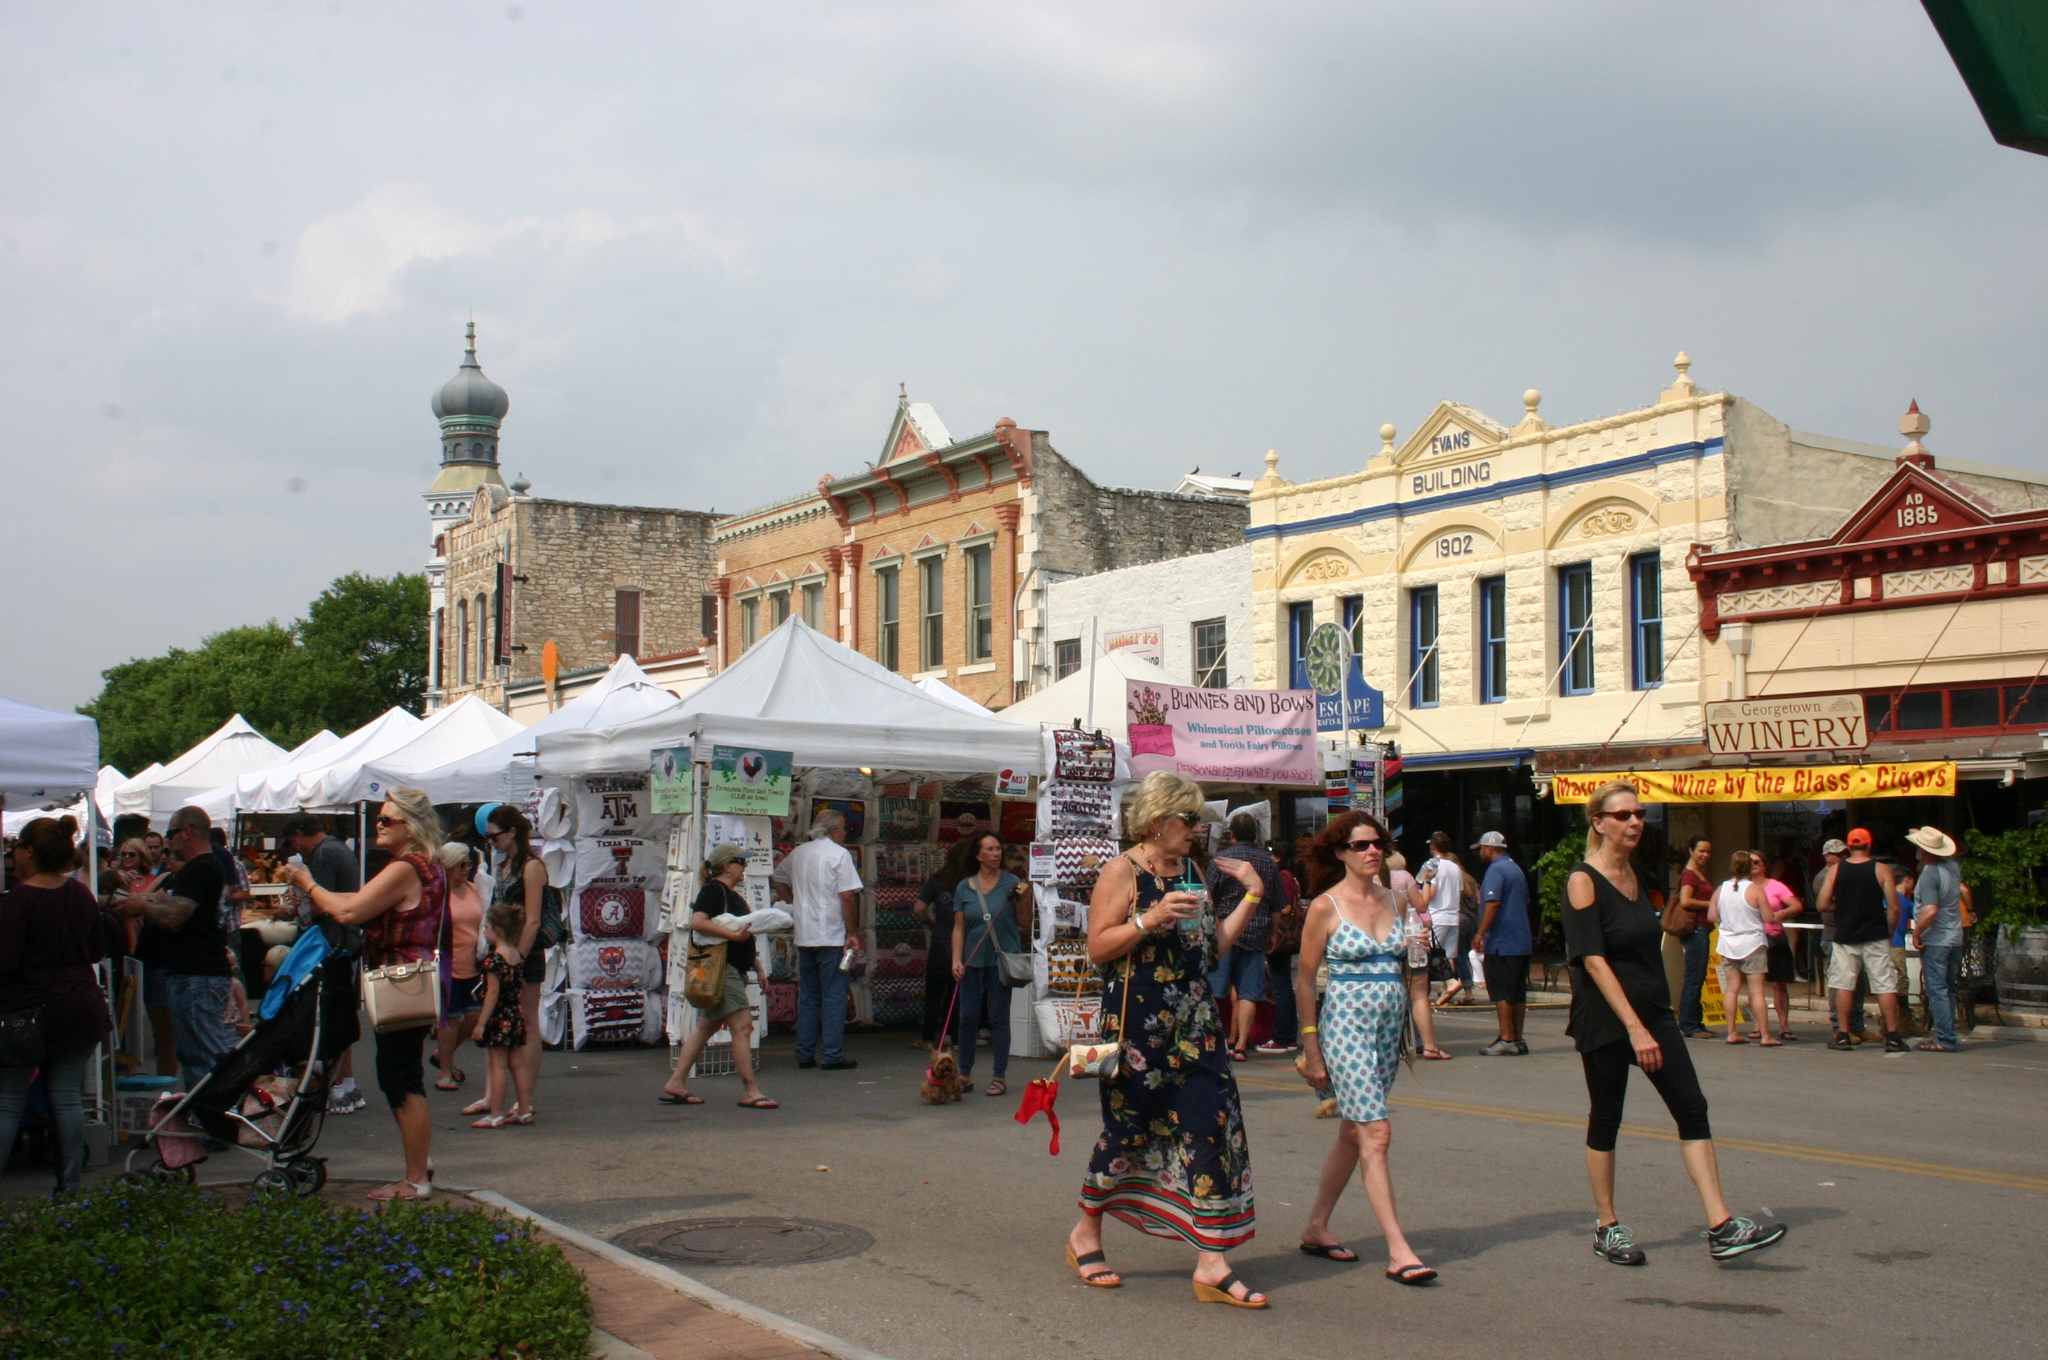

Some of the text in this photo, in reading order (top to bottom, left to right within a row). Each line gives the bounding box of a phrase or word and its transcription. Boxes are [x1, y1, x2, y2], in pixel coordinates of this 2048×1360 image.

[1431, 431, 1470, 455] EVANS
[1413, 461, 1490, 495] BUILDING
[1905, 493, 1923, 506] AD
[1897, 505, 1938, 528] 1885
[1435, 535, 1473, 558] 1902
[1107, 633, 1139, 651] MIKEY
[1270, 691, 1314, 715] BOWS
[1741, 702, 1822, 717] Georgetown
[1186, 721, 1313, 737] Whimsical Pillowcases
[1317, 717, 1335, 726] RAFTS
[1709, 715, 1862, 752] WINERY
[1200, 739, 1303, 752] and Tooth Fairy Pillows
[1011, 775, 1027, 784] M37
[1556, 775, 1650, 798] Margas
[1672, 773, 1717, 796] Wine
[1724, 772, 1746, 799] by
[1754, 770, 1785, 794] the
[1792, 769, 1850, 794] Glass
[1876, 765, 1947, 795] Cigars
[1062, 800, 1101, 818] AGGIES
[596, 895, 628, 911] ALABAMA
